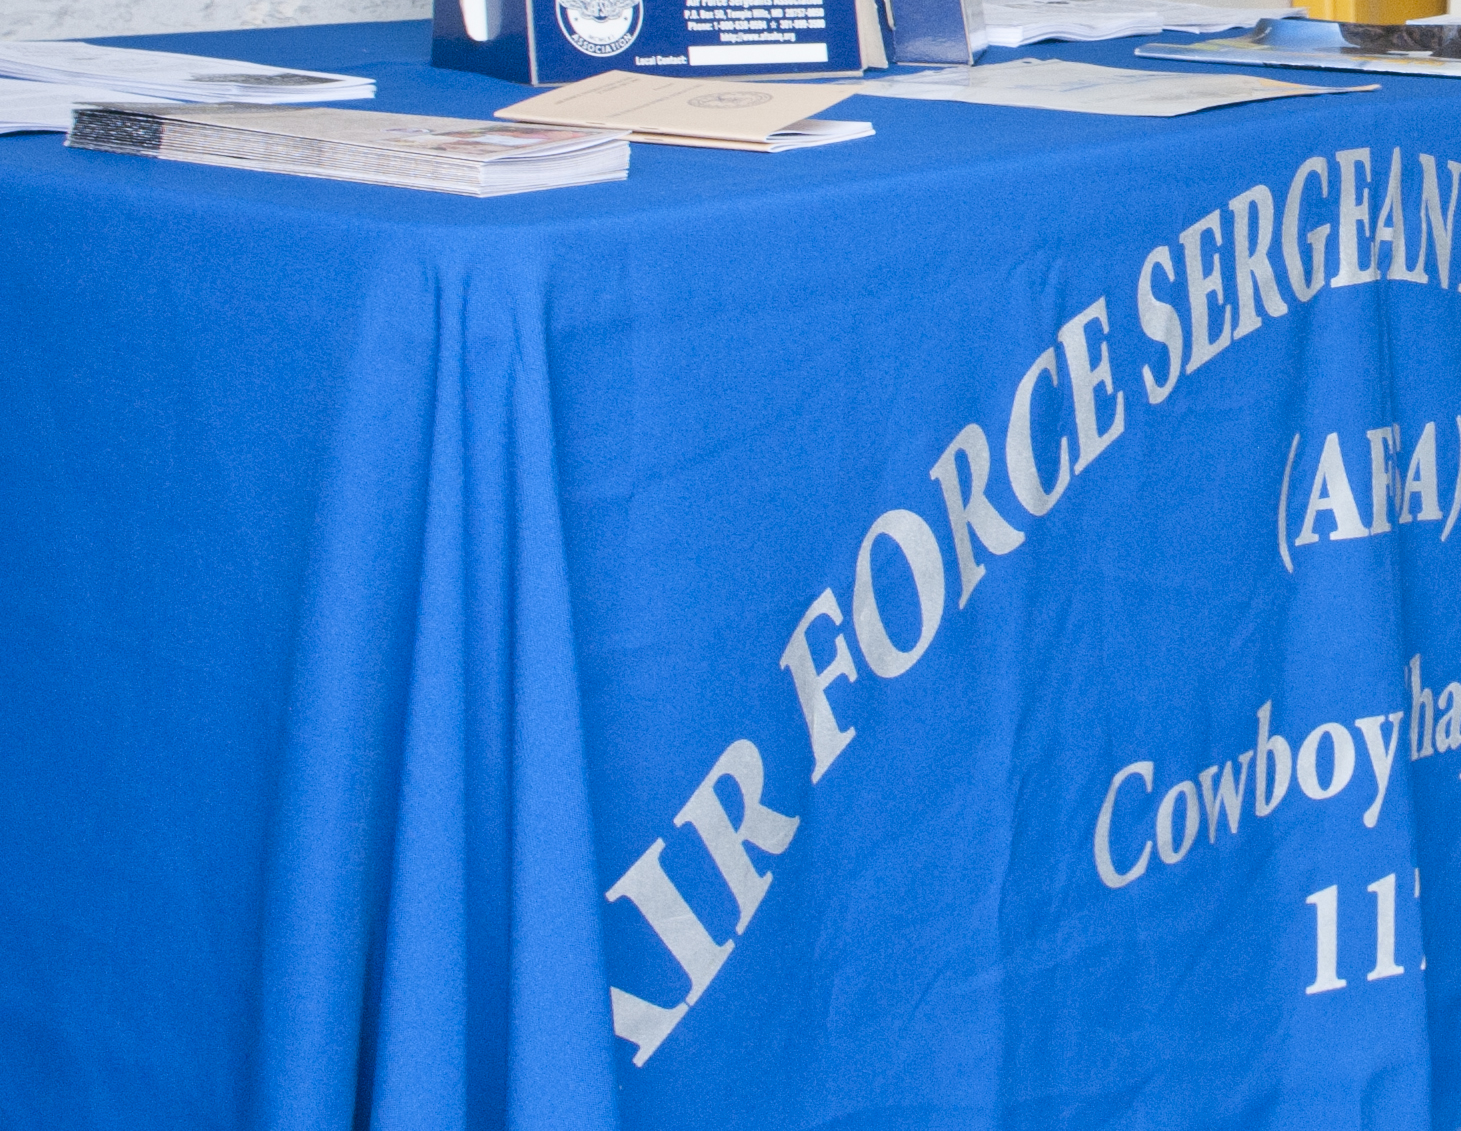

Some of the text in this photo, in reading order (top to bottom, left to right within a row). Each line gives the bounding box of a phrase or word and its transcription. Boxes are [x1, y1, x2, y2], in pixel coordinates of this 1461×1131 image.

[571, 33, 633, 54] ASSOCIATION
[635, 56, 656, 66] Local
[779, 295, 1126, 784] FORCE
[1093, 700, 1404, 889] Cowboy
[1305, 867, 1426, 995] 11
